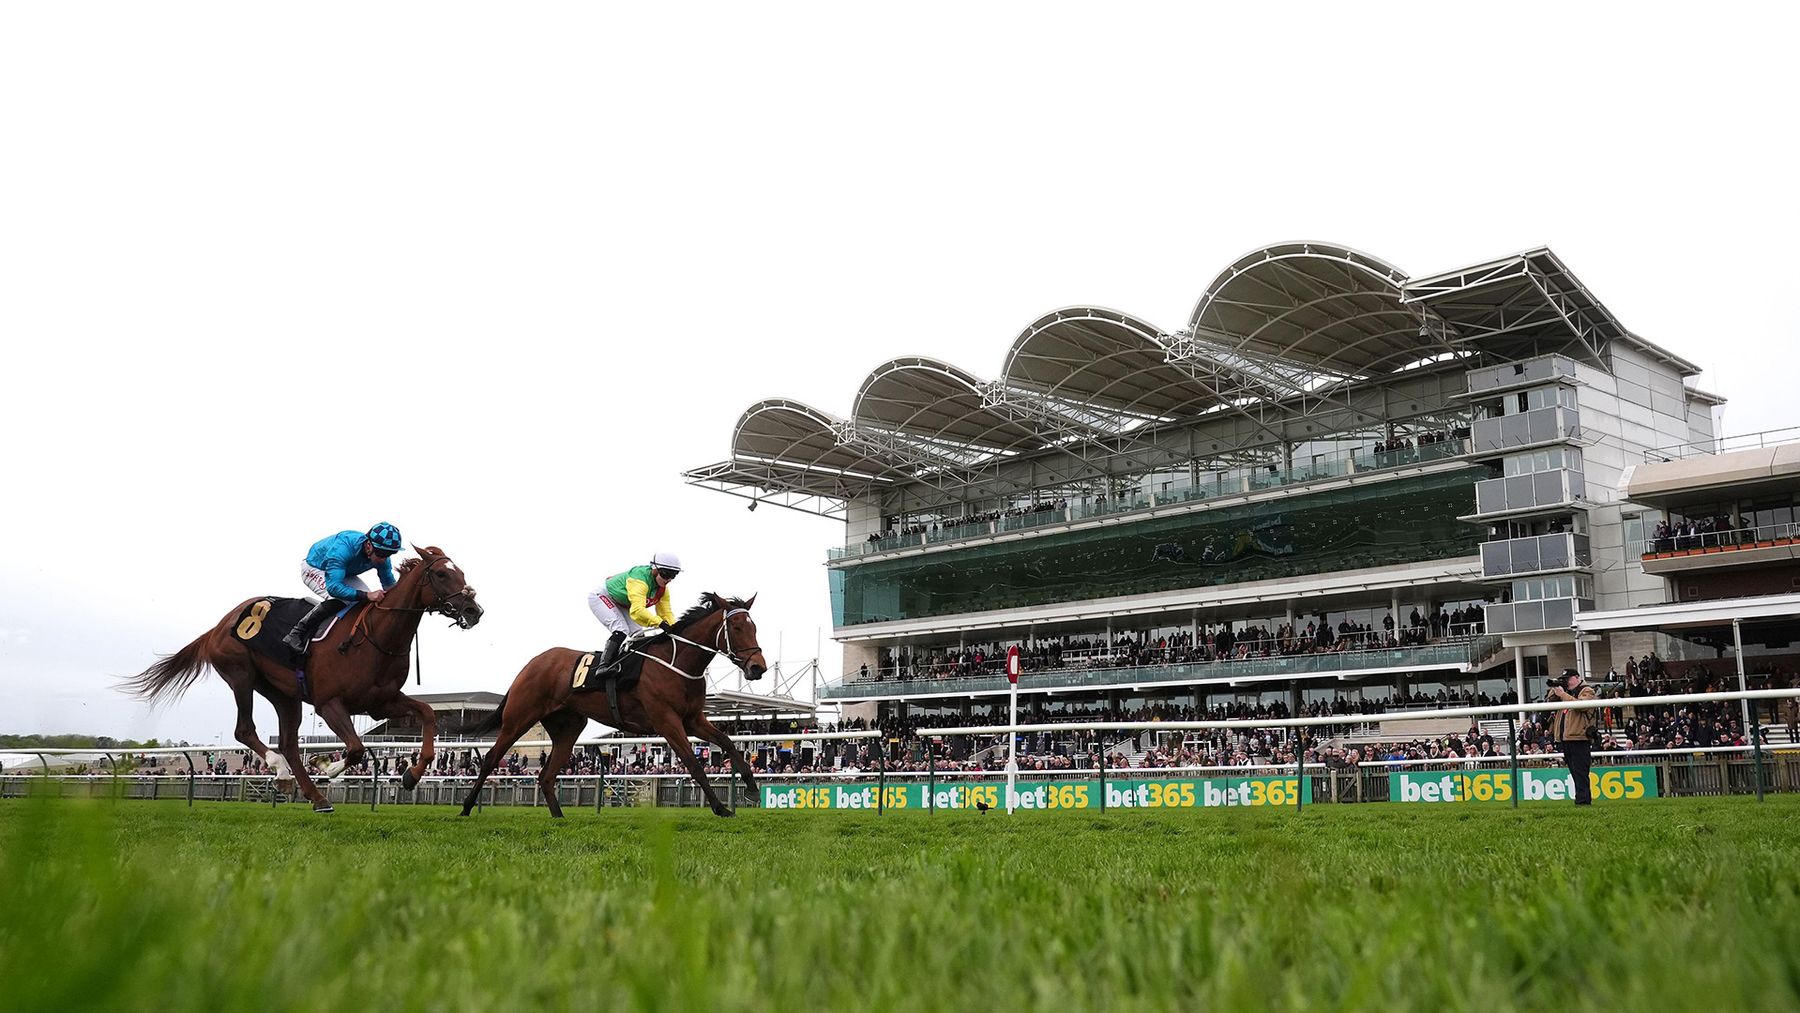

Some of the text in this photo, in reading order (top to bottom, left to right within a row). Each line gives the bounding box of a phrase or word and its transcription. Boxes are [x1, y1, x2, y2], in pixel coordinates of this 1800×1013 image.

[237, 600, 271, 640] 8
[572, 654, 595, 688] 6
[765, 787, 831, 809] bet365
[836, 786, 907, 809] bet365
[922, 785, 998, 809] bet365
[1106, 781, 1194, 808] bet365
[1204, 780, 1300, 807] bet365
[1400, 774, 1512, 802] bet365
